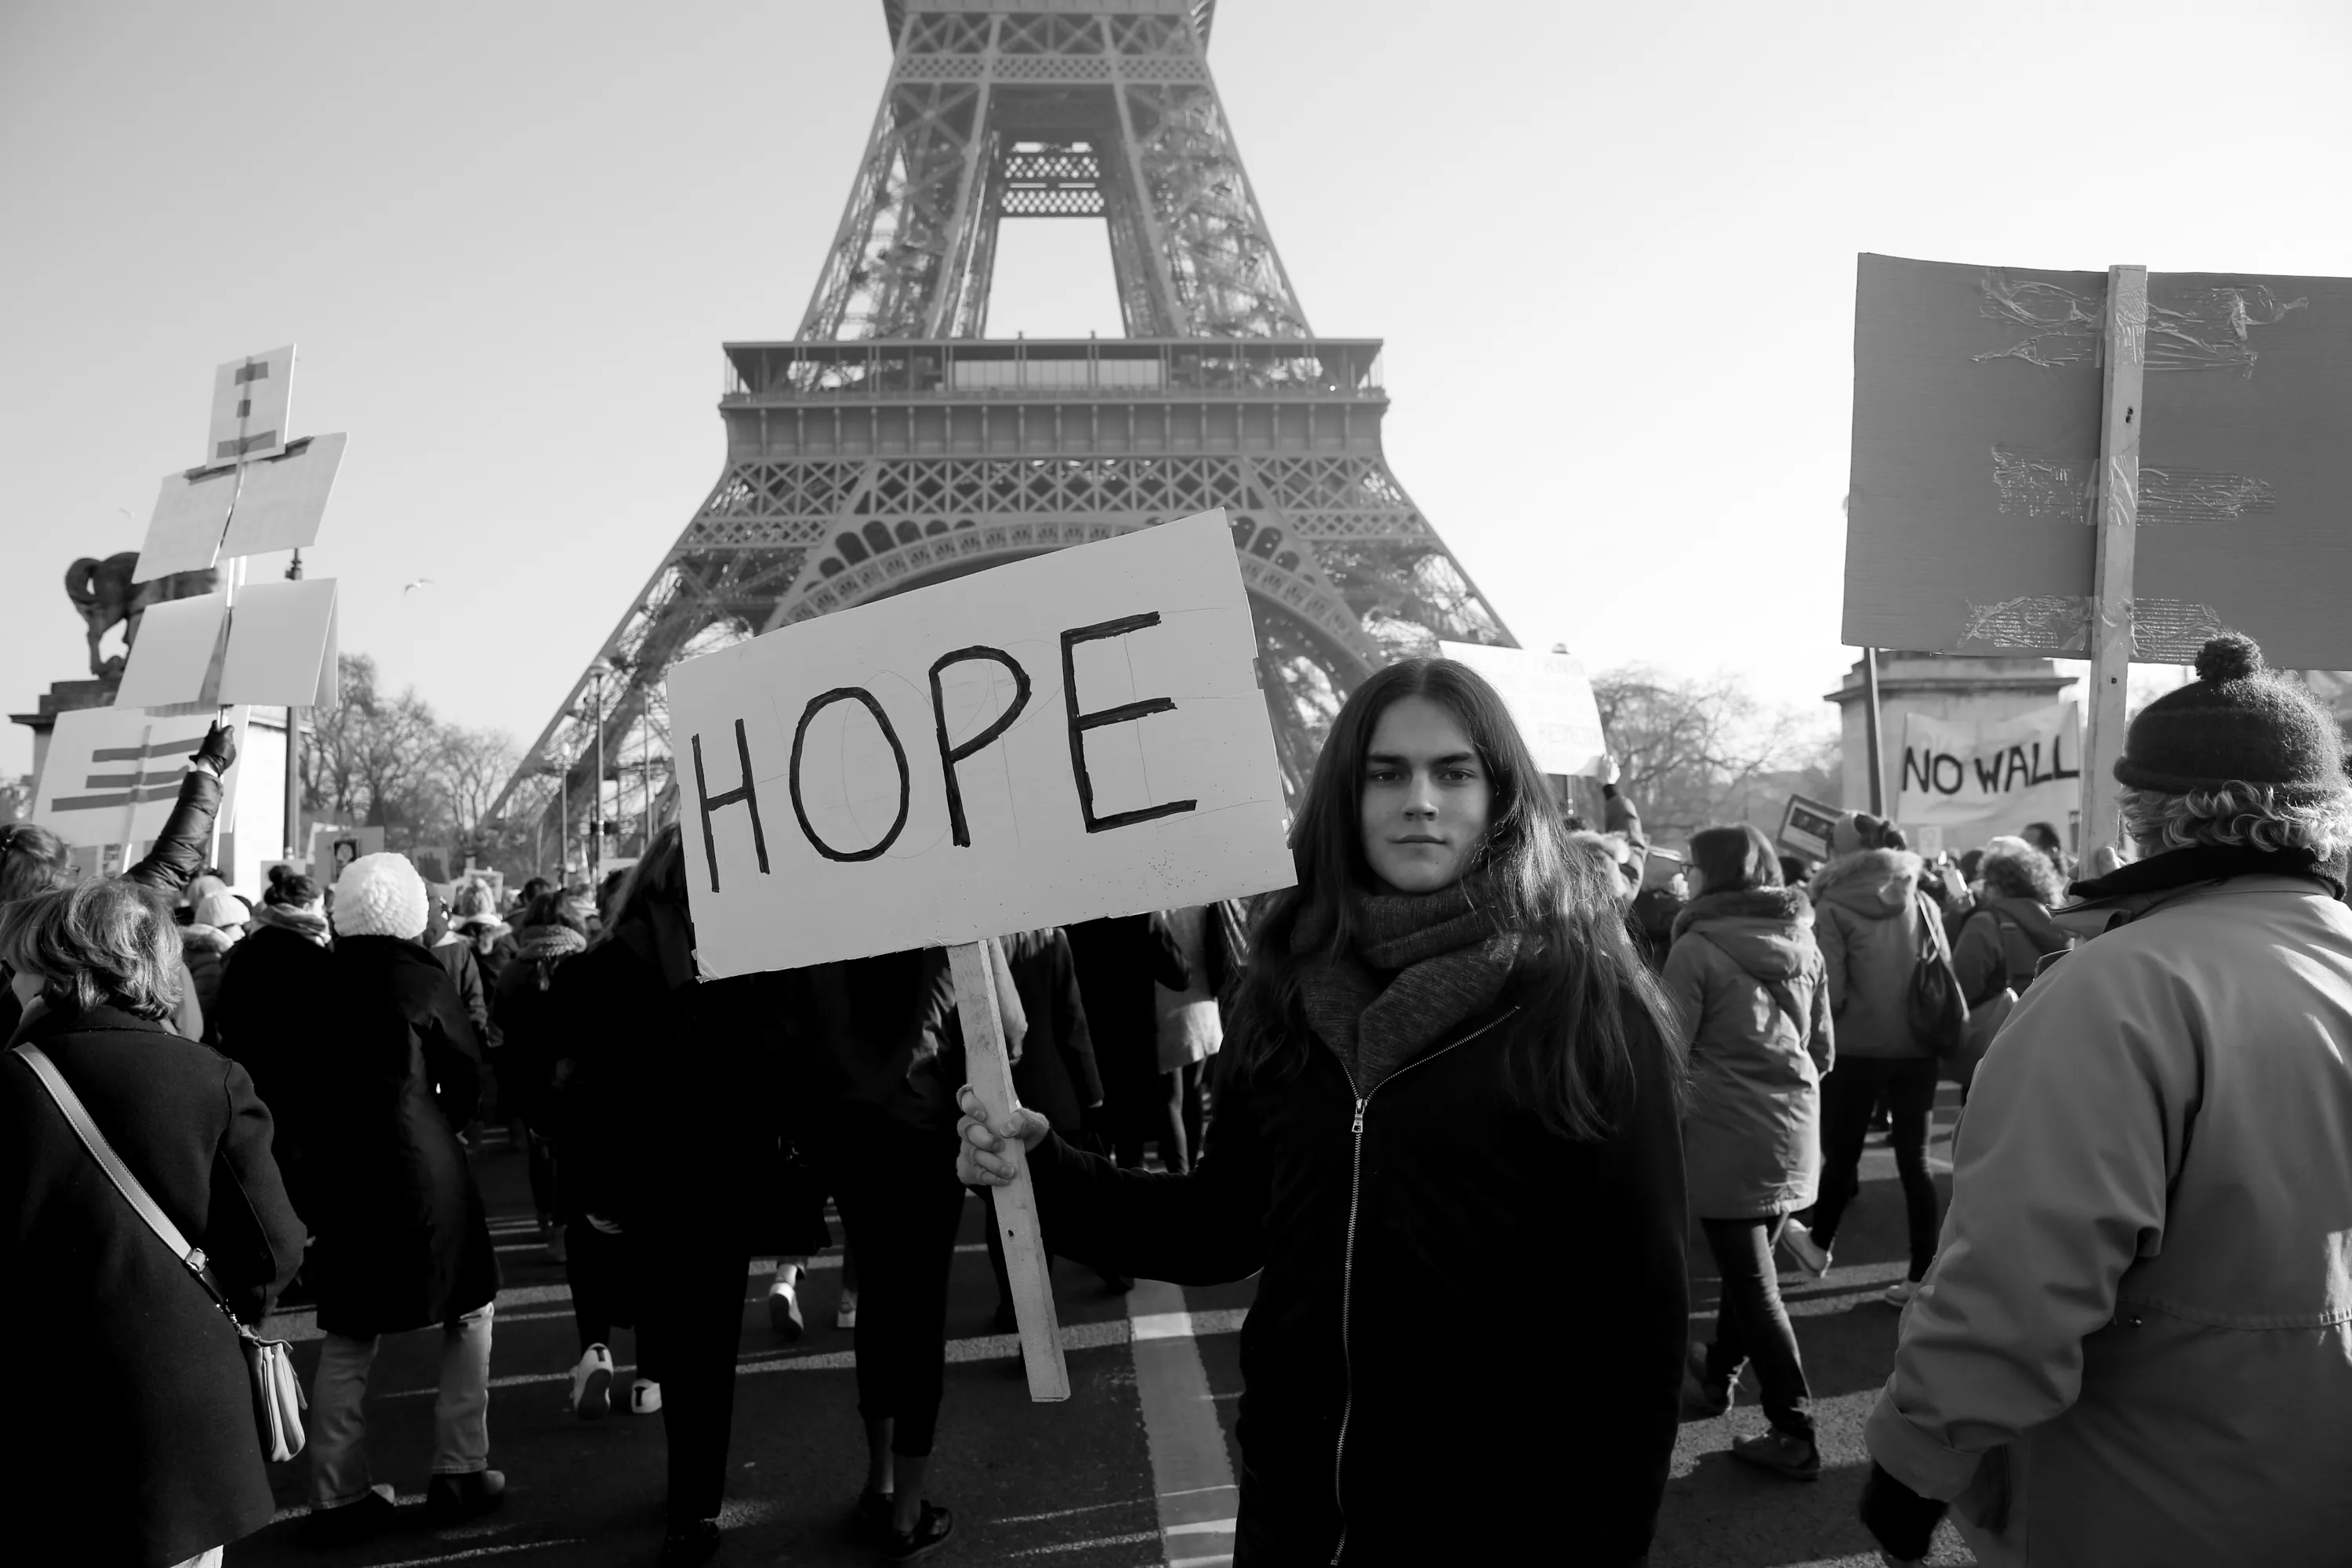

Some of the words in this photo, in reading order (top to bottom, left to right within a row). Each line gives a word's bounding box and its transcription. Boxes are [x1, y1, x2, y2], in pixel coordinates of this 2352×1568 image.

[691, 611, 1198, 893] HOPE
[1902, 746, 1963, 795] NO
[1974, 734, 2080, 793] WALL
